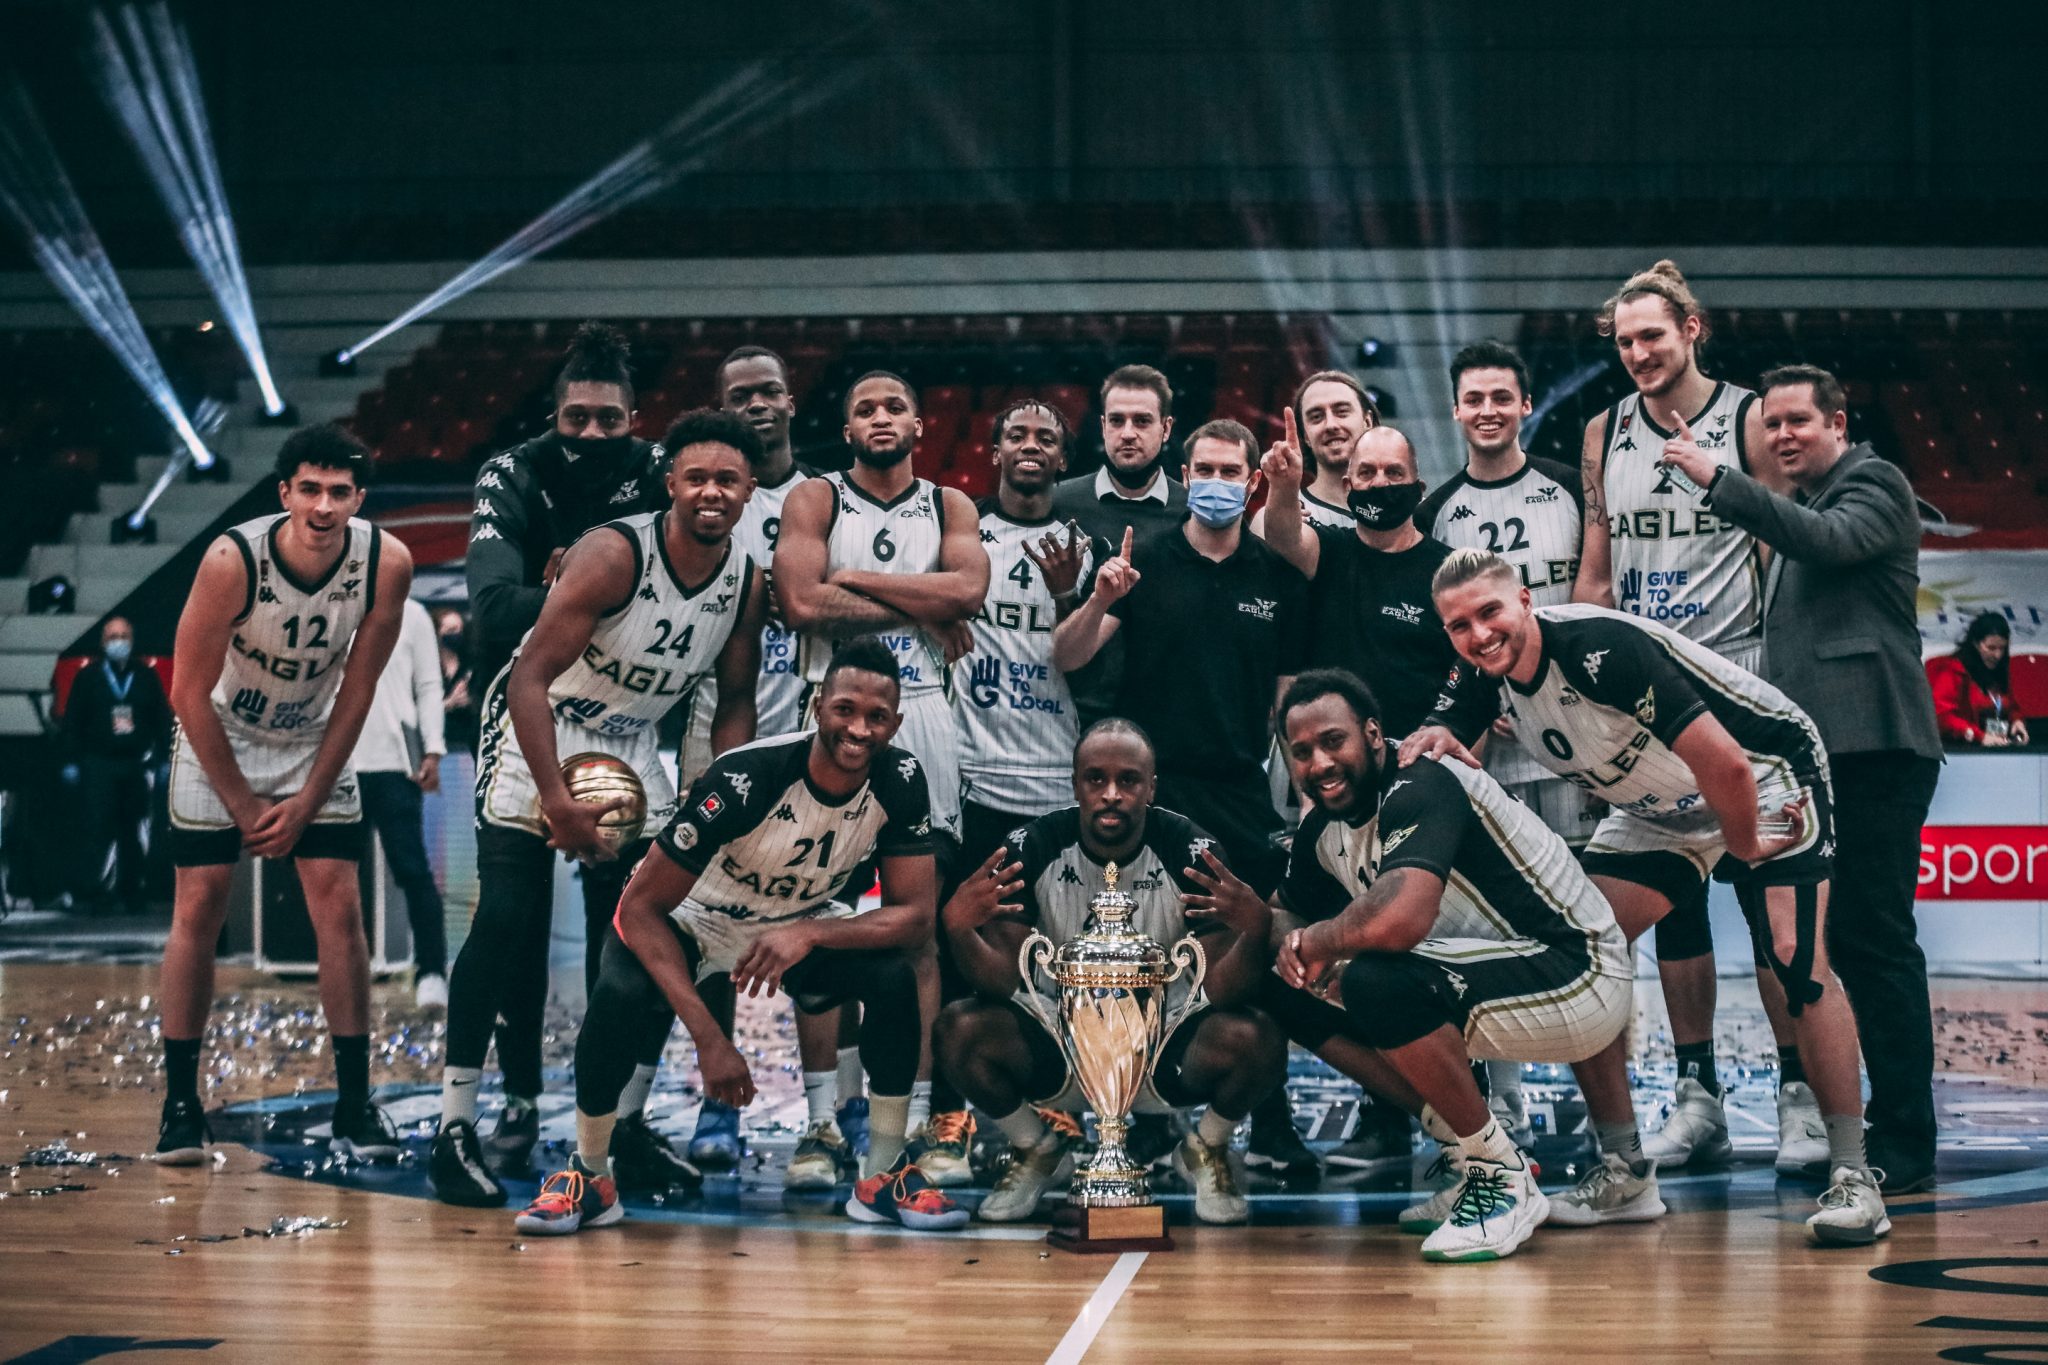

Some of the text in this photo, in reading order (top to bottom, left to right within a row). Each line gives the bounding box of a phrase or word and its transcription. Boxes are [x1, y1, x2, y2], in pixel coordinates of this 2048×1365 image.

[872, 527, 896, 562] 6
[1478, 516, 1530, 553] 22
[1008, 557, 1033, 590] 4
[1647, 570, 1688, 587] GIVE
[1647, 588, 1670, 603] TO
[967, 600, 1053, 635] AGL
[1647, 602, 1710, 620] LOCAL
[282, 614, 328, 649] 12
[643, 618, 695, 659] 24
[880, 634, 912, 651] IVE
[765, 643, 789, 658] TO
[1008, 661, 1048, 681] GIVE
[1008, 678, 1031, 694] TO
[1009, 694, 1064, 715] LOCAL
[1541, 728, 1574, 761] 0
[783, 829, 837, 869] 21
